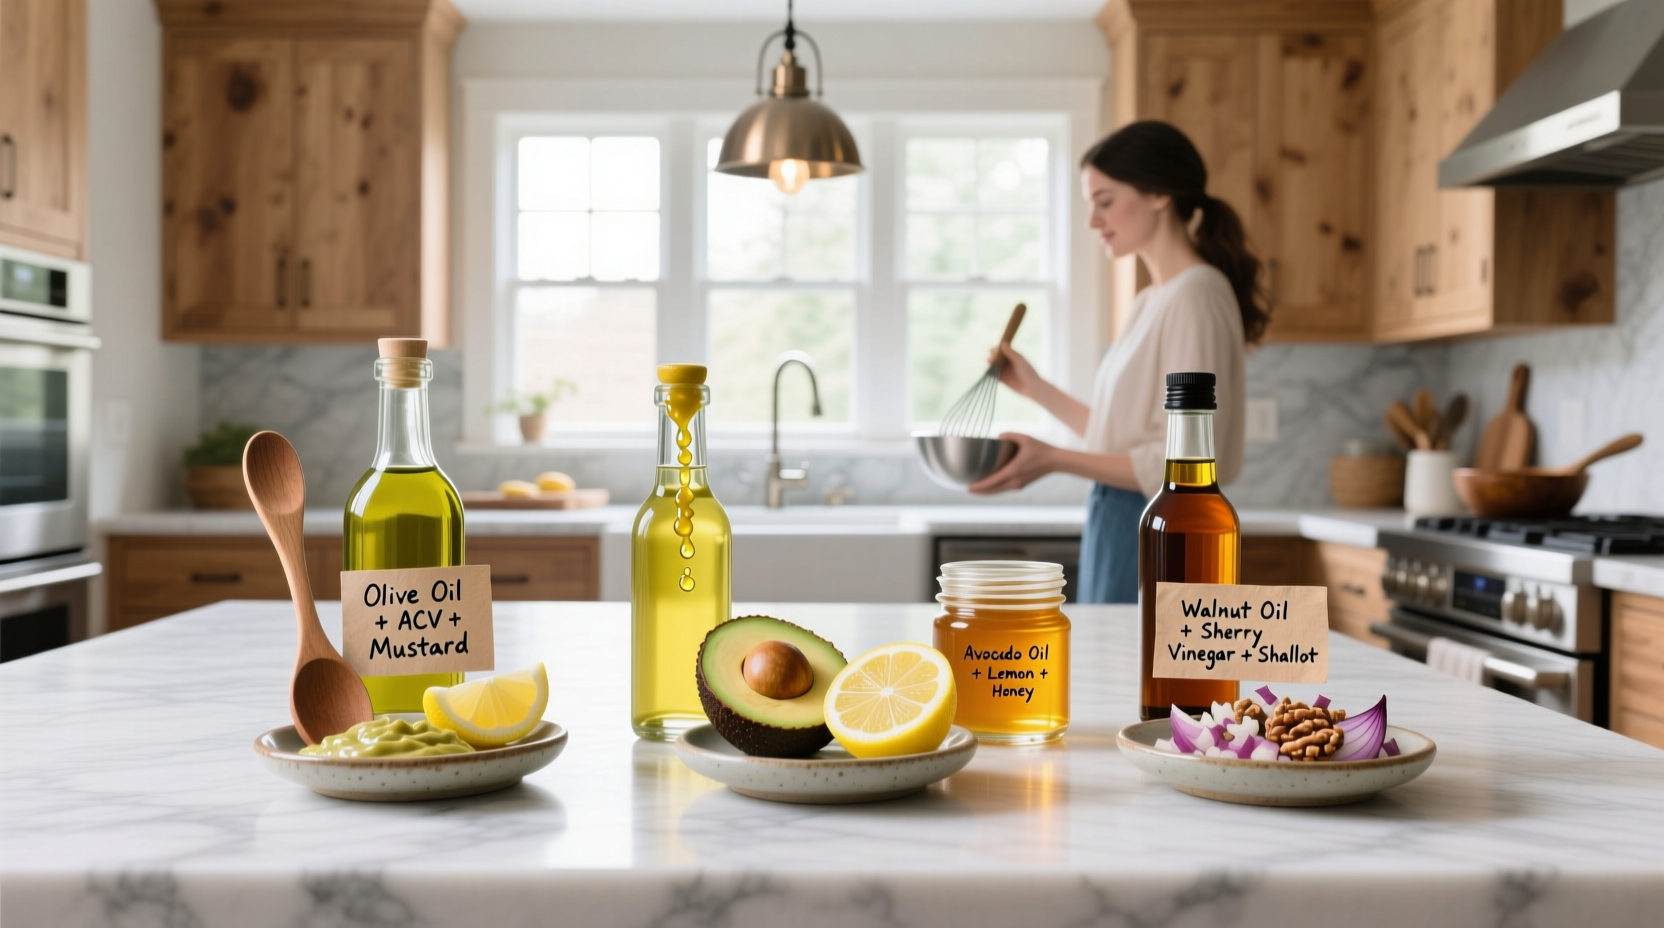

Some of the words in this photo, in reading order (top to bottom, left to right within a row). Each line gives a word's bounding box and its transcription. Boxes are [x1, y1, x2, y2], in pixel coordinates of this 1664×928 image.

[364, 583, 419, 607] Olive
[431, 579, 461, 602] Oil
[375, 615, 388, 630] +
[398, 609, 443, 630] ACV
[449, 612, 461, 627] +
[1181, 599, 1252, 619] Walnut
[1260, 601, 1288, 620] Oil
[369, 631, 468, 660] Mustard
[1180, 624, 1192, 637] +
[1201, 622, 1263, 648] Sherry
[1028, 644, 1049, 660] Oil
[1168, 643, 1235, 670] Vinegar
[1241, 649, 1252, 662] +
[1258, 645, 1318, 663] Shallot
[972, 668, 981, 679] +
[987, 666, 1034, 680] Lemon
[1039, 668, 1048, 679] +
[992, 684, 1034, 703] Honey
